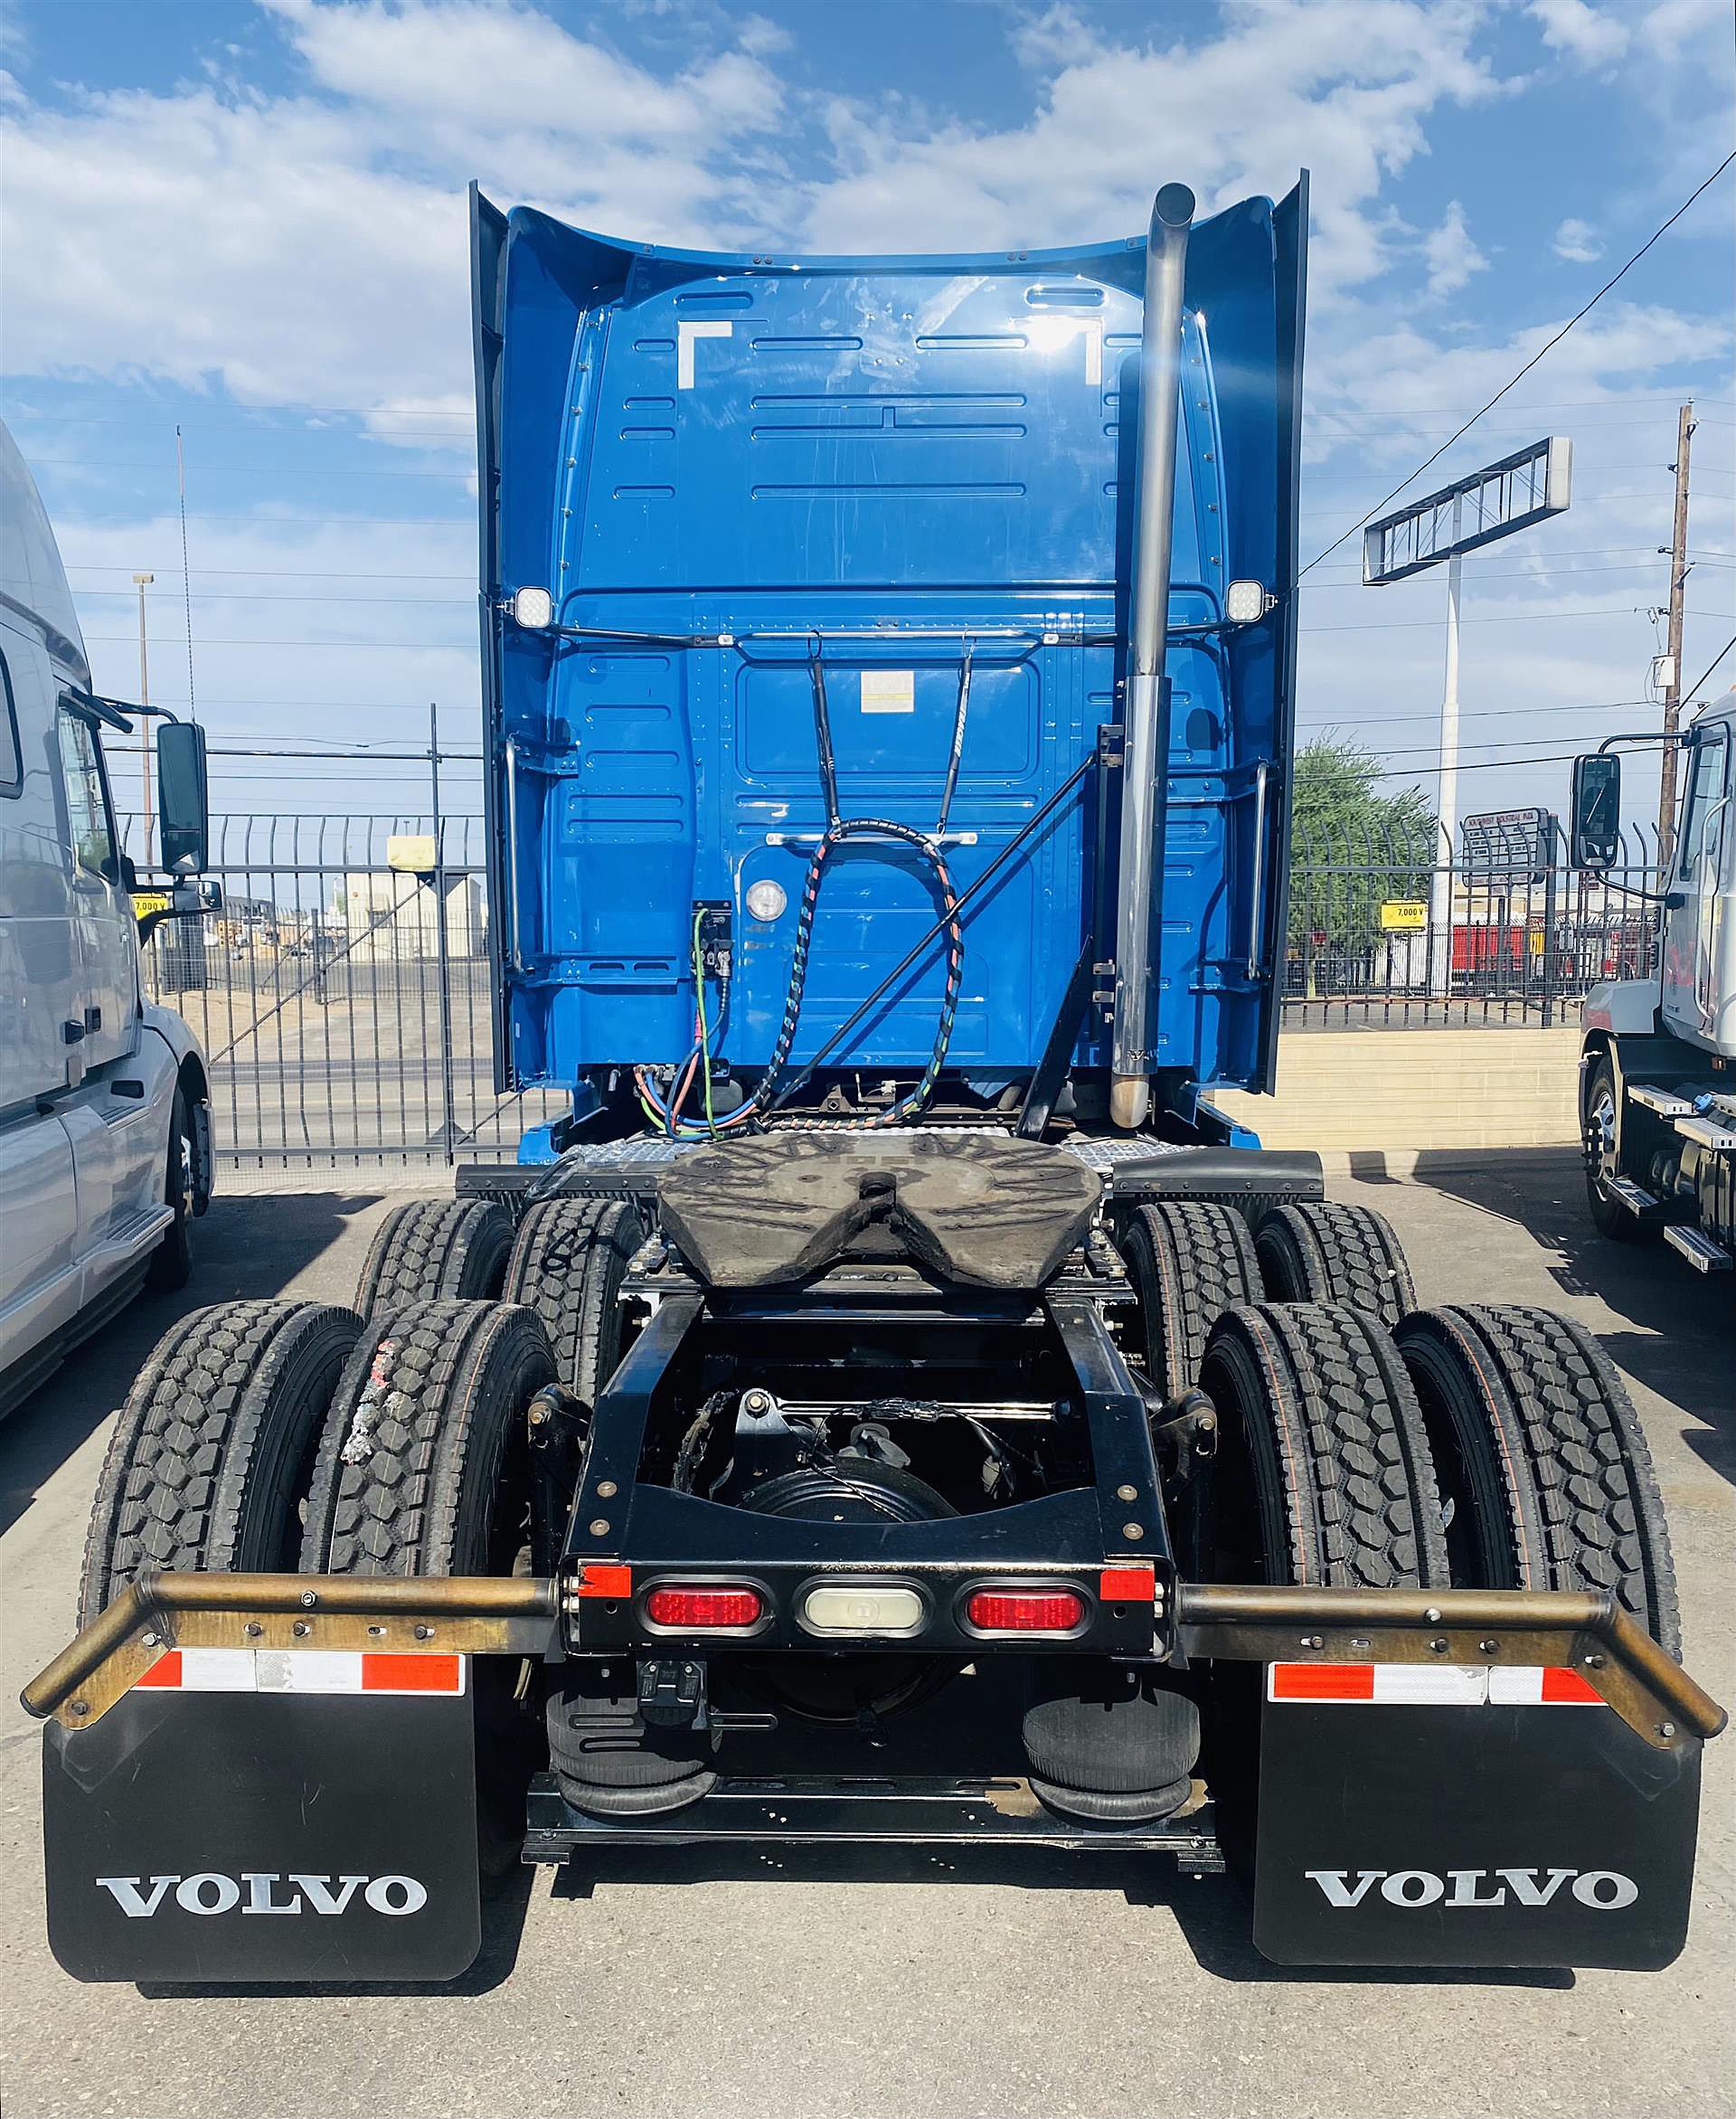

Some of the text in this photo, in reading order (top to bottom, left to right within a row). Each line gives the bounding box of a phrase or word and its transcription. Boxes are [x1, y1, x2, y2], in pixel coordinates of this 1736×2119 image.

[136, 902, 158, 911] 7,000
[1397, 908, 1418, 917] 7,000
[96, 1872, 429, 1918] VOLVO
[1305, 1868, 1639, 1910] VOLVO
